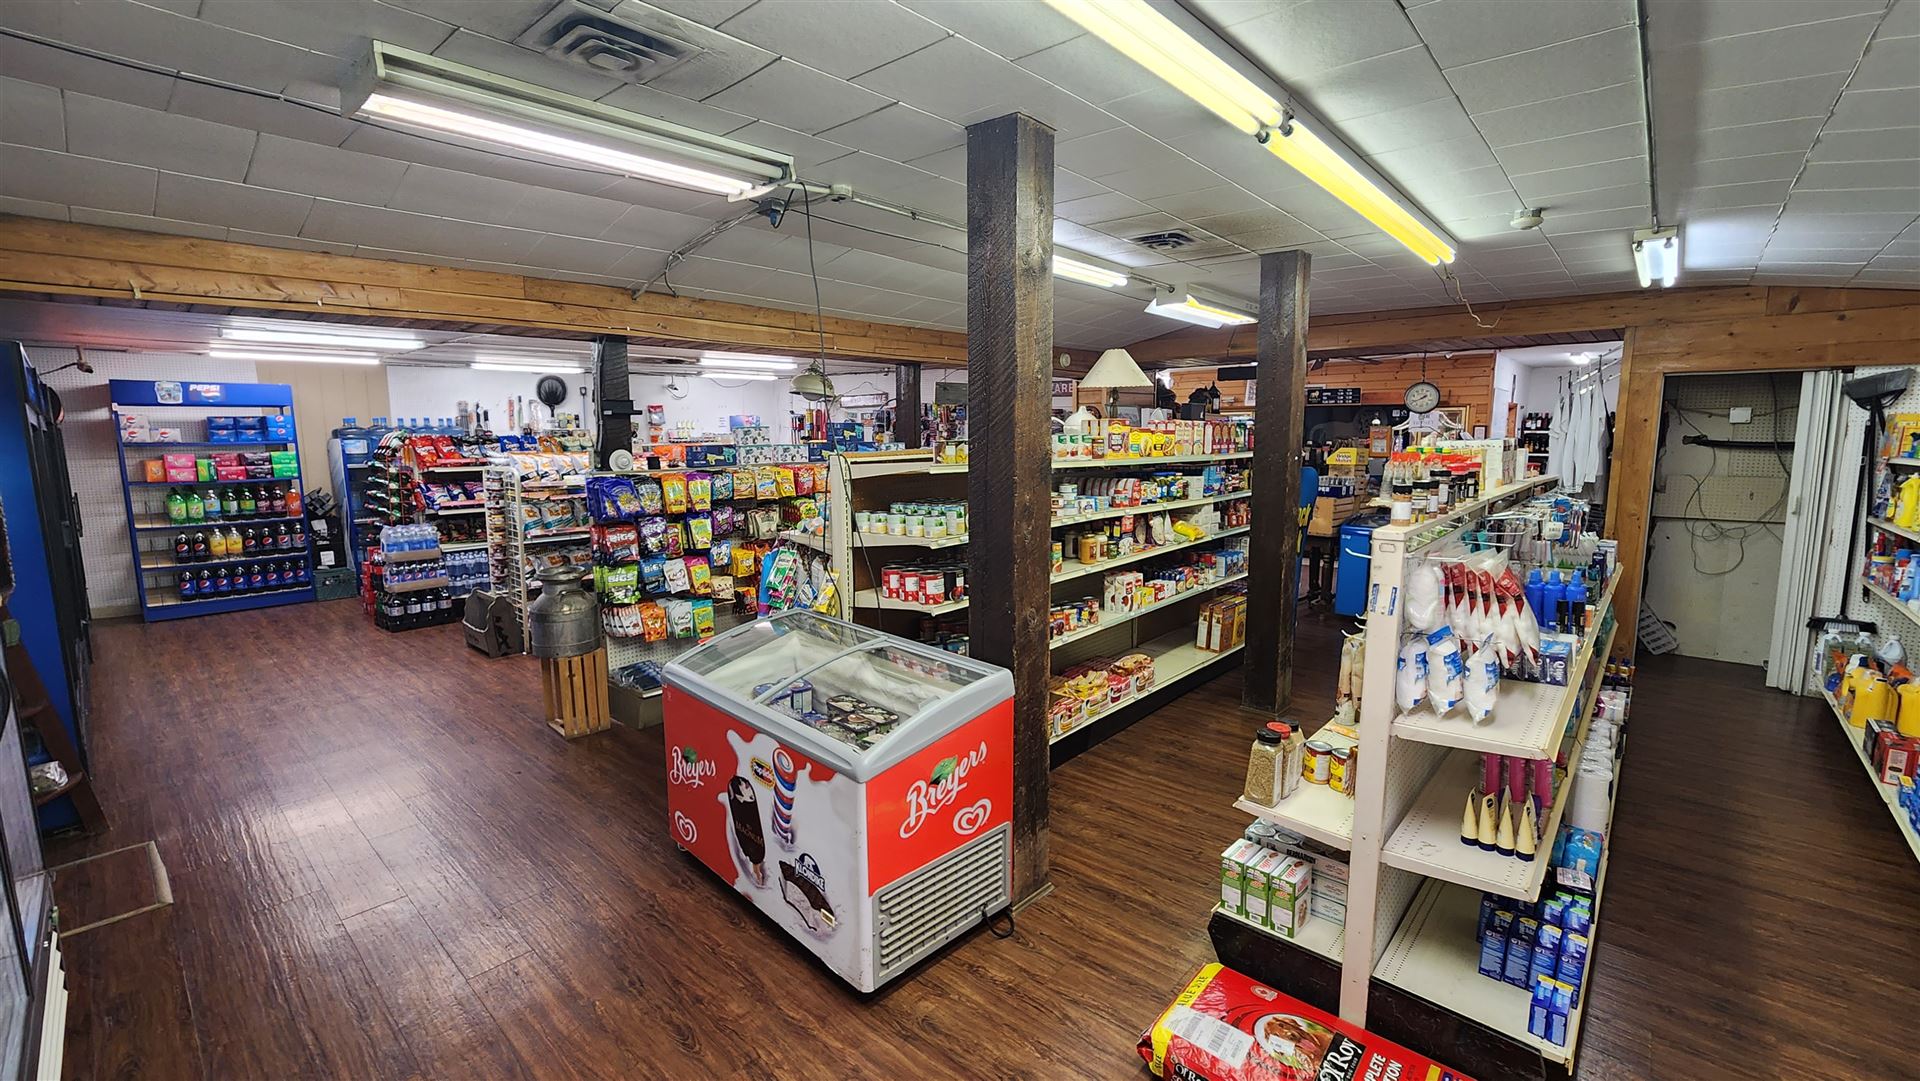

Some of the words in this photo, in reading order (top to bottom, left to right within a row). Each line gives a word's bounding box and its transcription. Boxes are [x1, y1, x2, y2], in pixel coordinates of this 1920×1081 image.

[1052, 382, 1073, 394] ARE
[670, 746, 717, 788] Breyers
[899, 740, 988, 839] Breyers
[795, 860, 825, 891] KLONDIKE
[1177, 990, 1196, 1006] LUE
